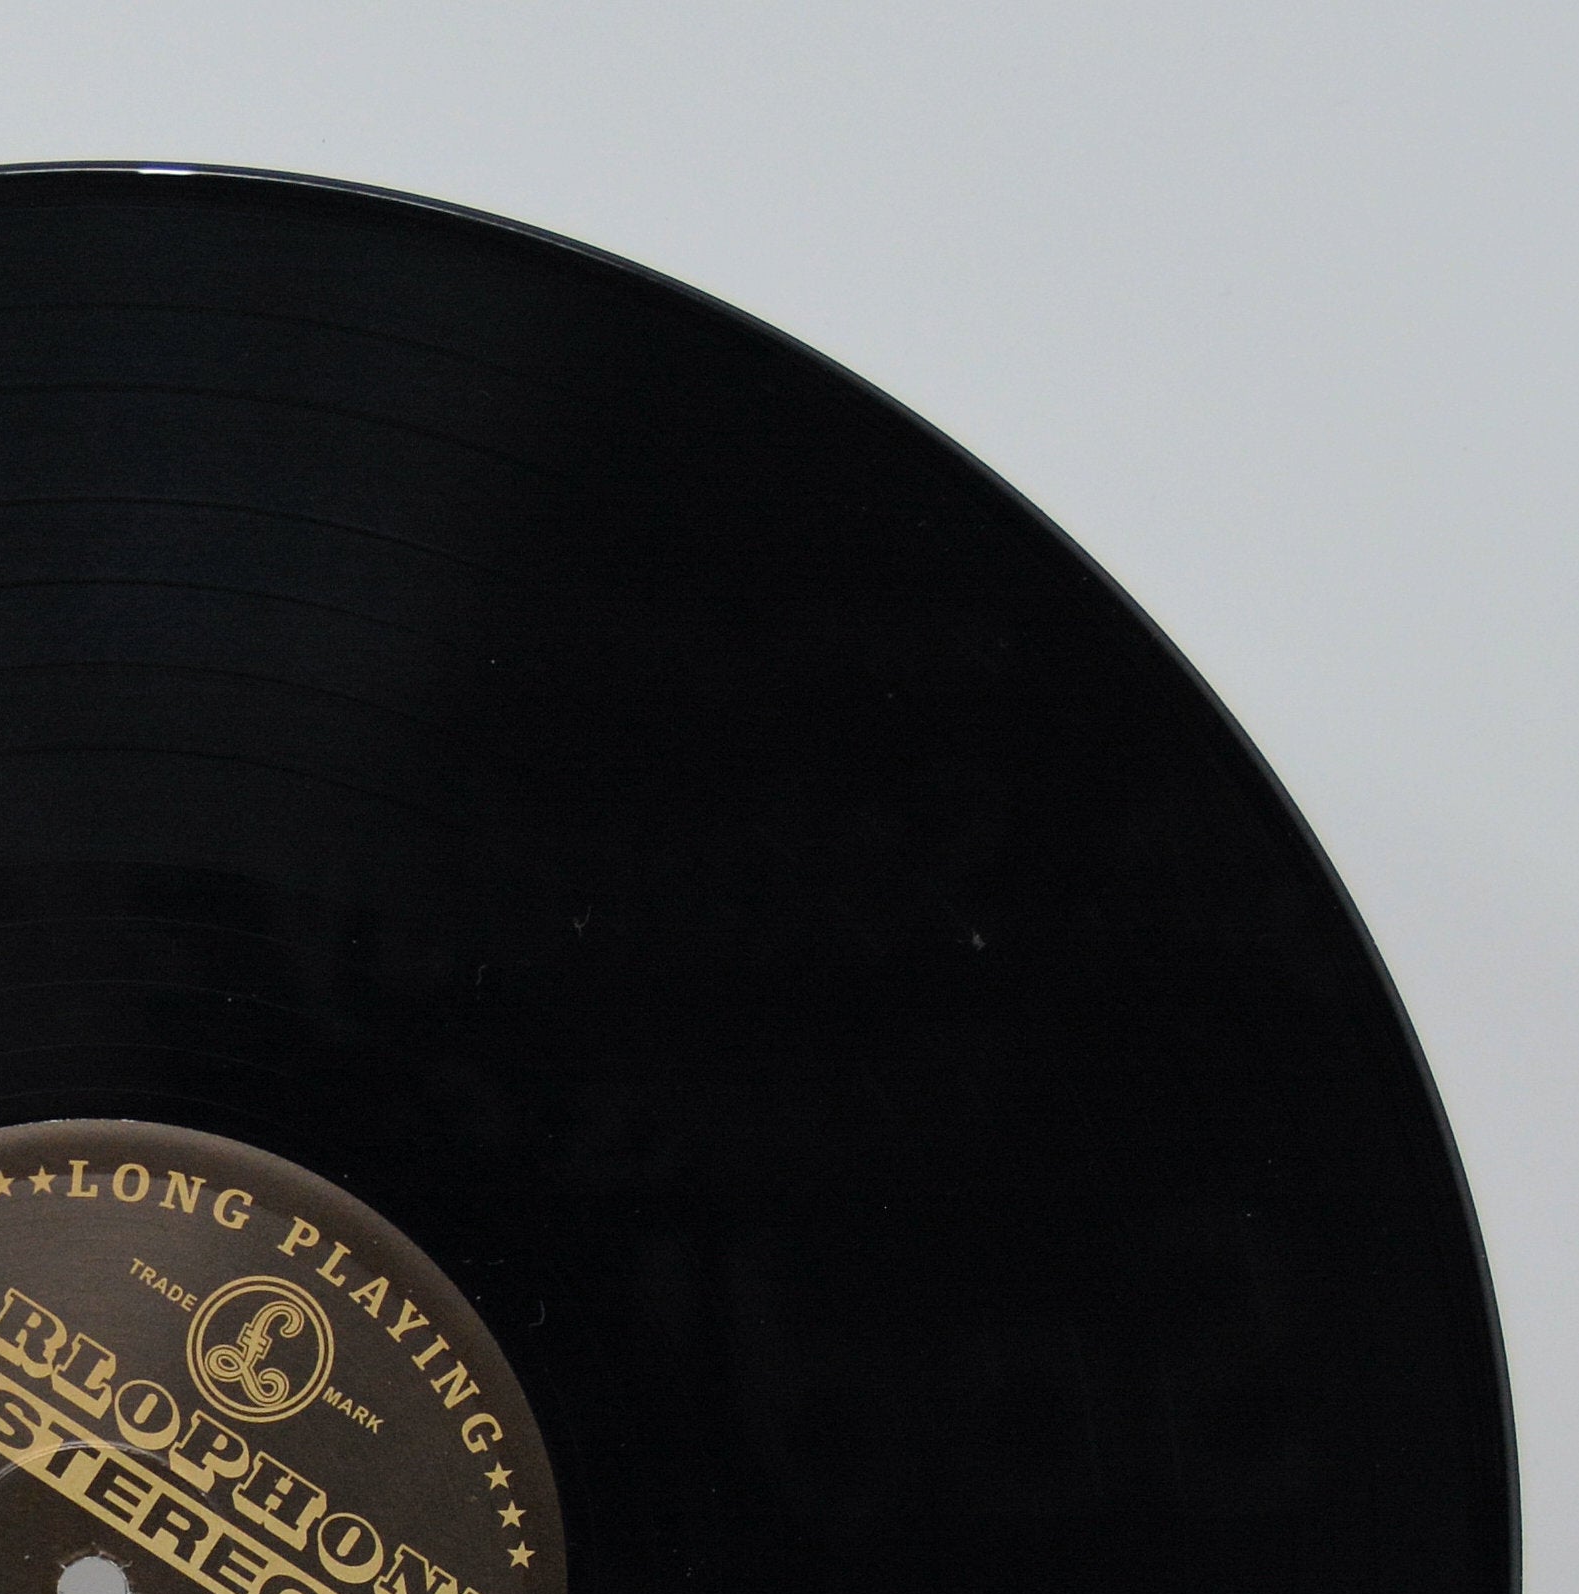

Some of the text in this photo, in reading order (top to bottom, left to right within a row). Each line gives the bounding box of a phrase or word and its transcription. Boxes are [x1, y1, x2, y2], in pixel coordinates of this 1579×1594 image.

[65, 1158, 504, 1455] LONG PLAYING
[128, 1257, 386, 1435] TRADE MARK
